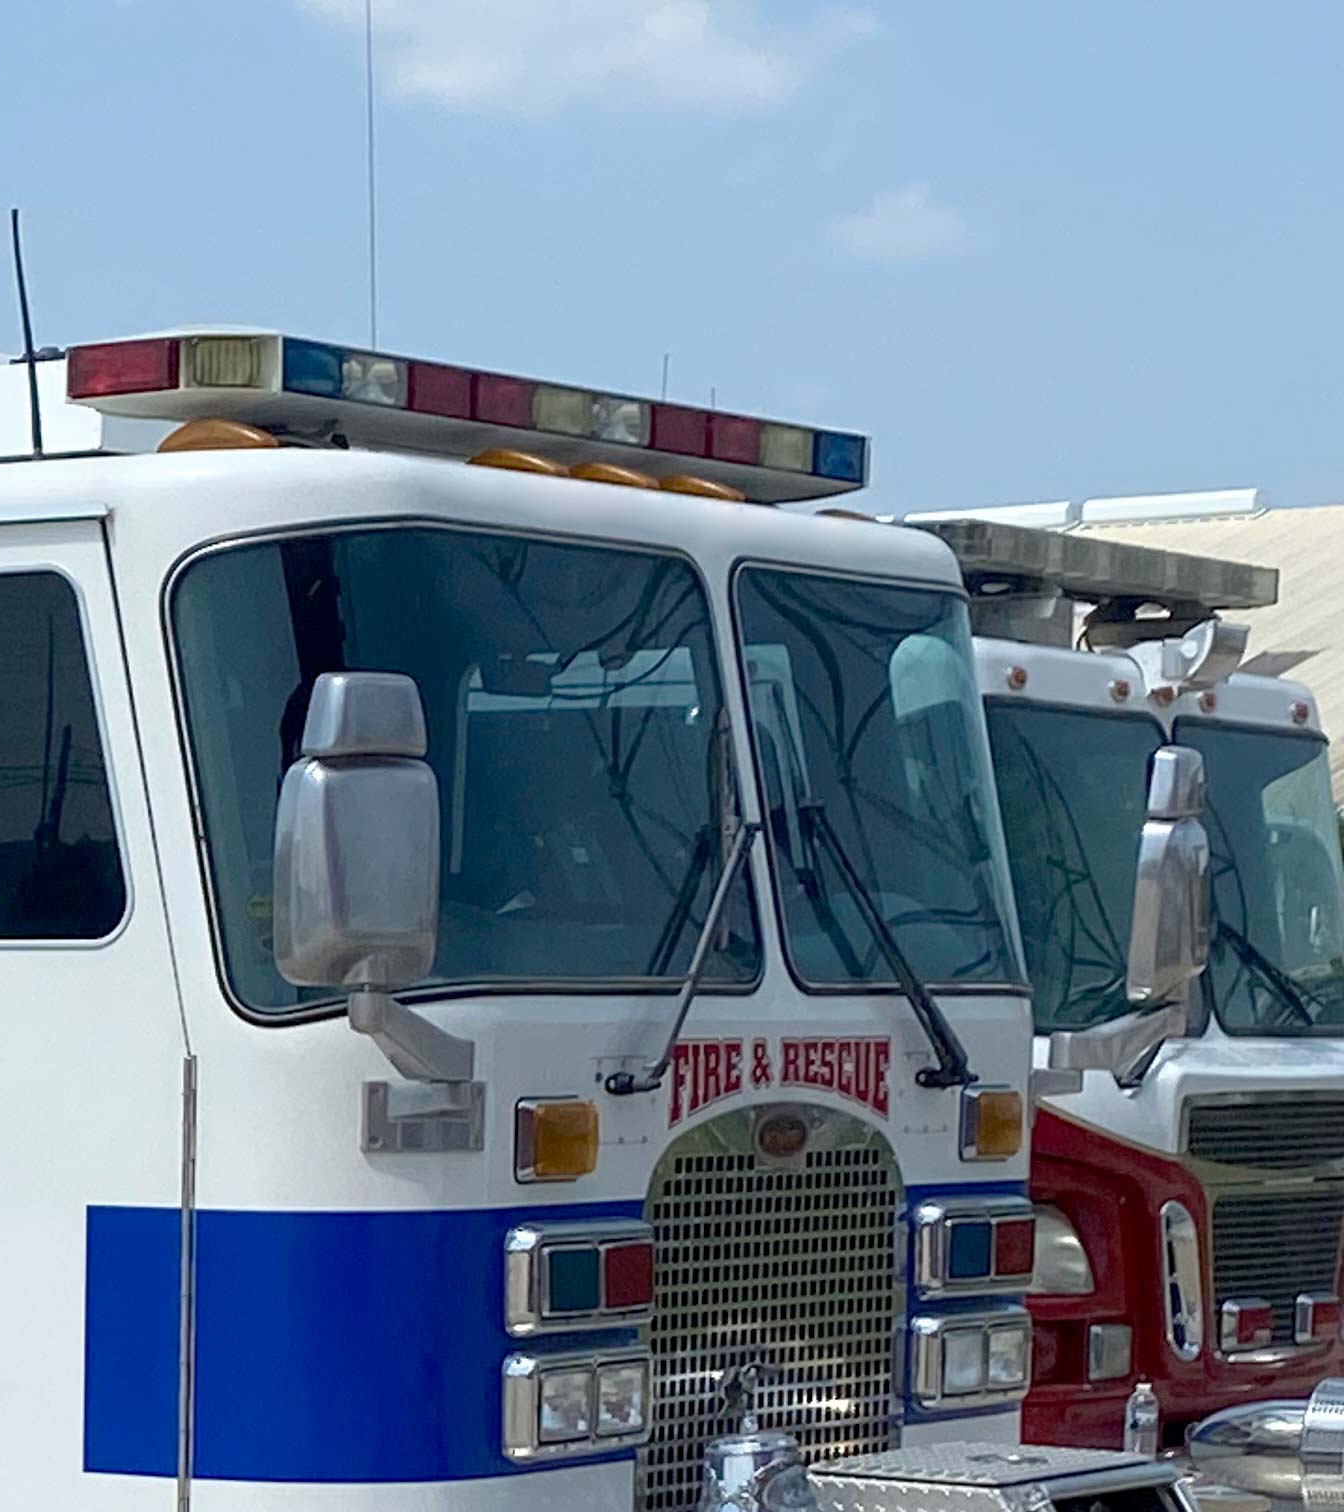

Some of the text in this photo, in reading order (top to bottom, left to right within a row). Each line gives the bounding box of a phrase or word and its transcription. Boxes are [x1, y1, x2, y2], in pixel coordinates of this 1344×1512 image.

[667, 1035, 892, 1130] FIRE & RESCUE
